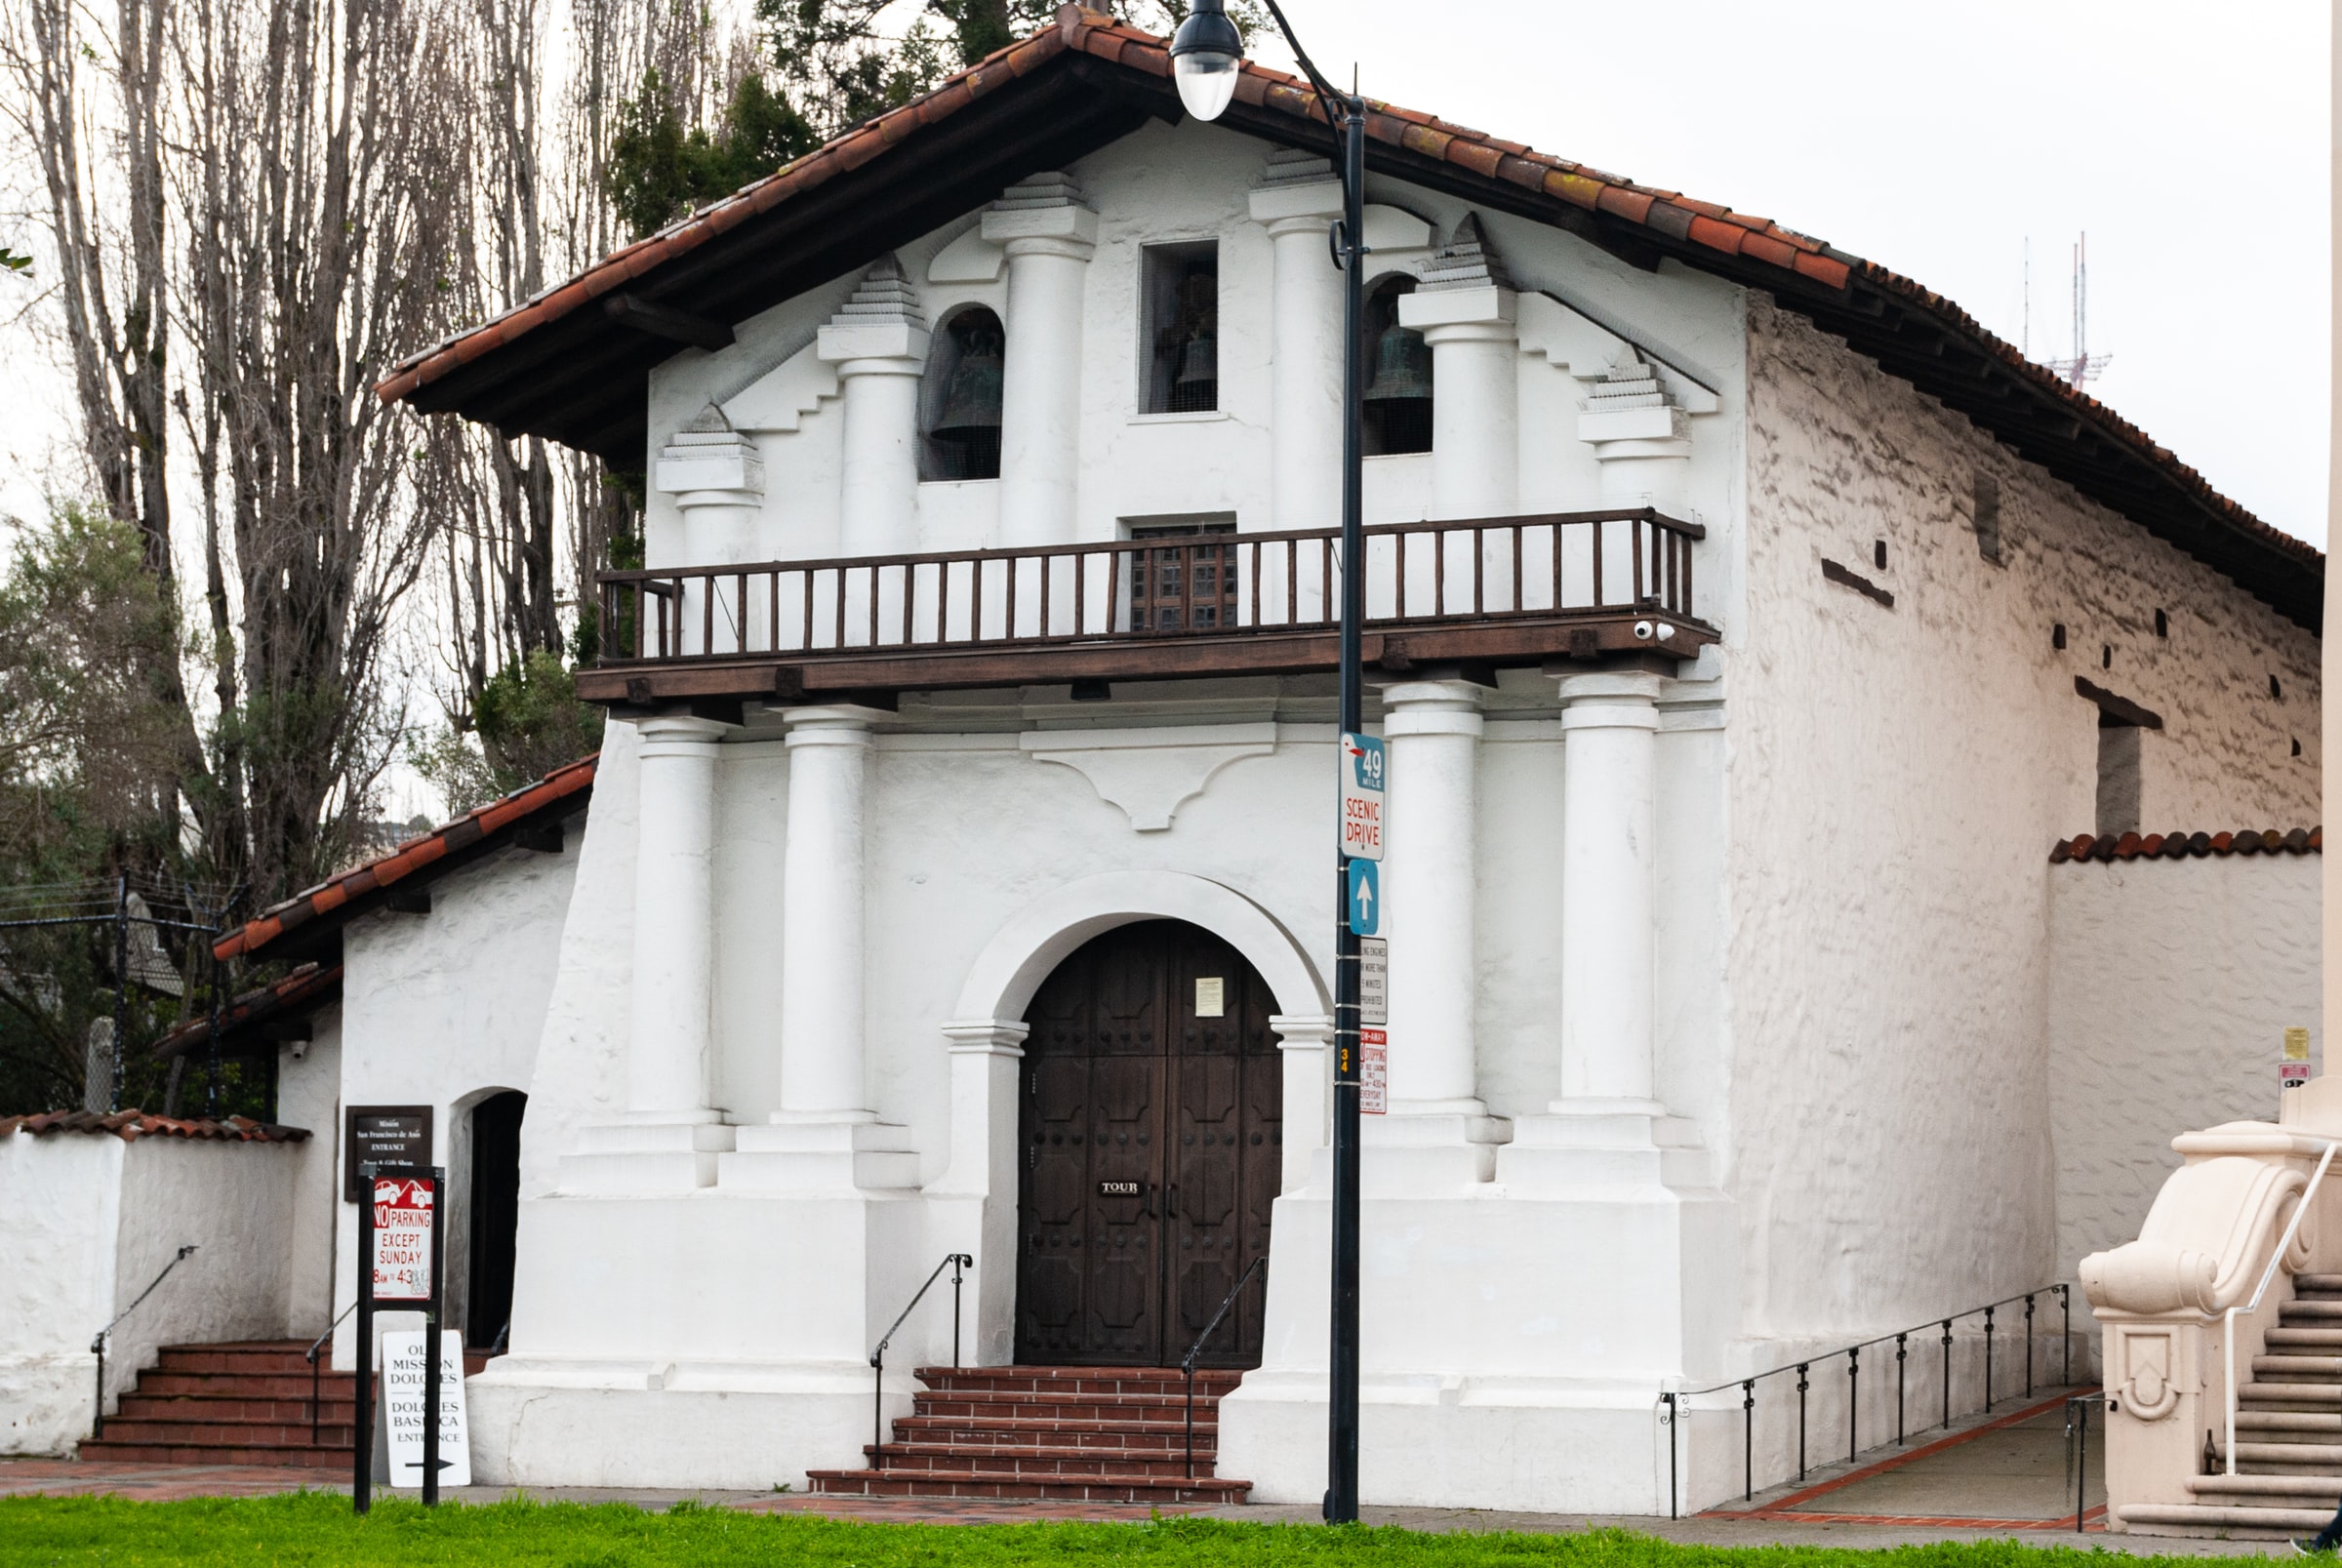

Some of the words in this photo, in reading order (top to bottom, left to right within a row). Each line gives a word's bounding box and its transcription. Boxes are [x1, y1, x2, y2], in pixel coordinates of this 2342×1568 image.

[1362, 749, 1382, 779] 49
[1362, 778, 1381, 788] MILE
[1347, 798, 1379, 821] SCENIC
[1347, 822, 1379, 846] DRIVE
[1102, 1183, 1138, 1192] TOUR
[375, 1205, 389, 1227] NO
[391, 1211, 430, 1227] PARKING
[383, 1233, 421, 1247] EXCEPT
[380, 1251, 422, 1265] SUNDAY
[408, 1345, 426, 1356] OL
[393, 1359, 453, 1370] MISSN
[390, 1374, 458, 1385] DOLOES
